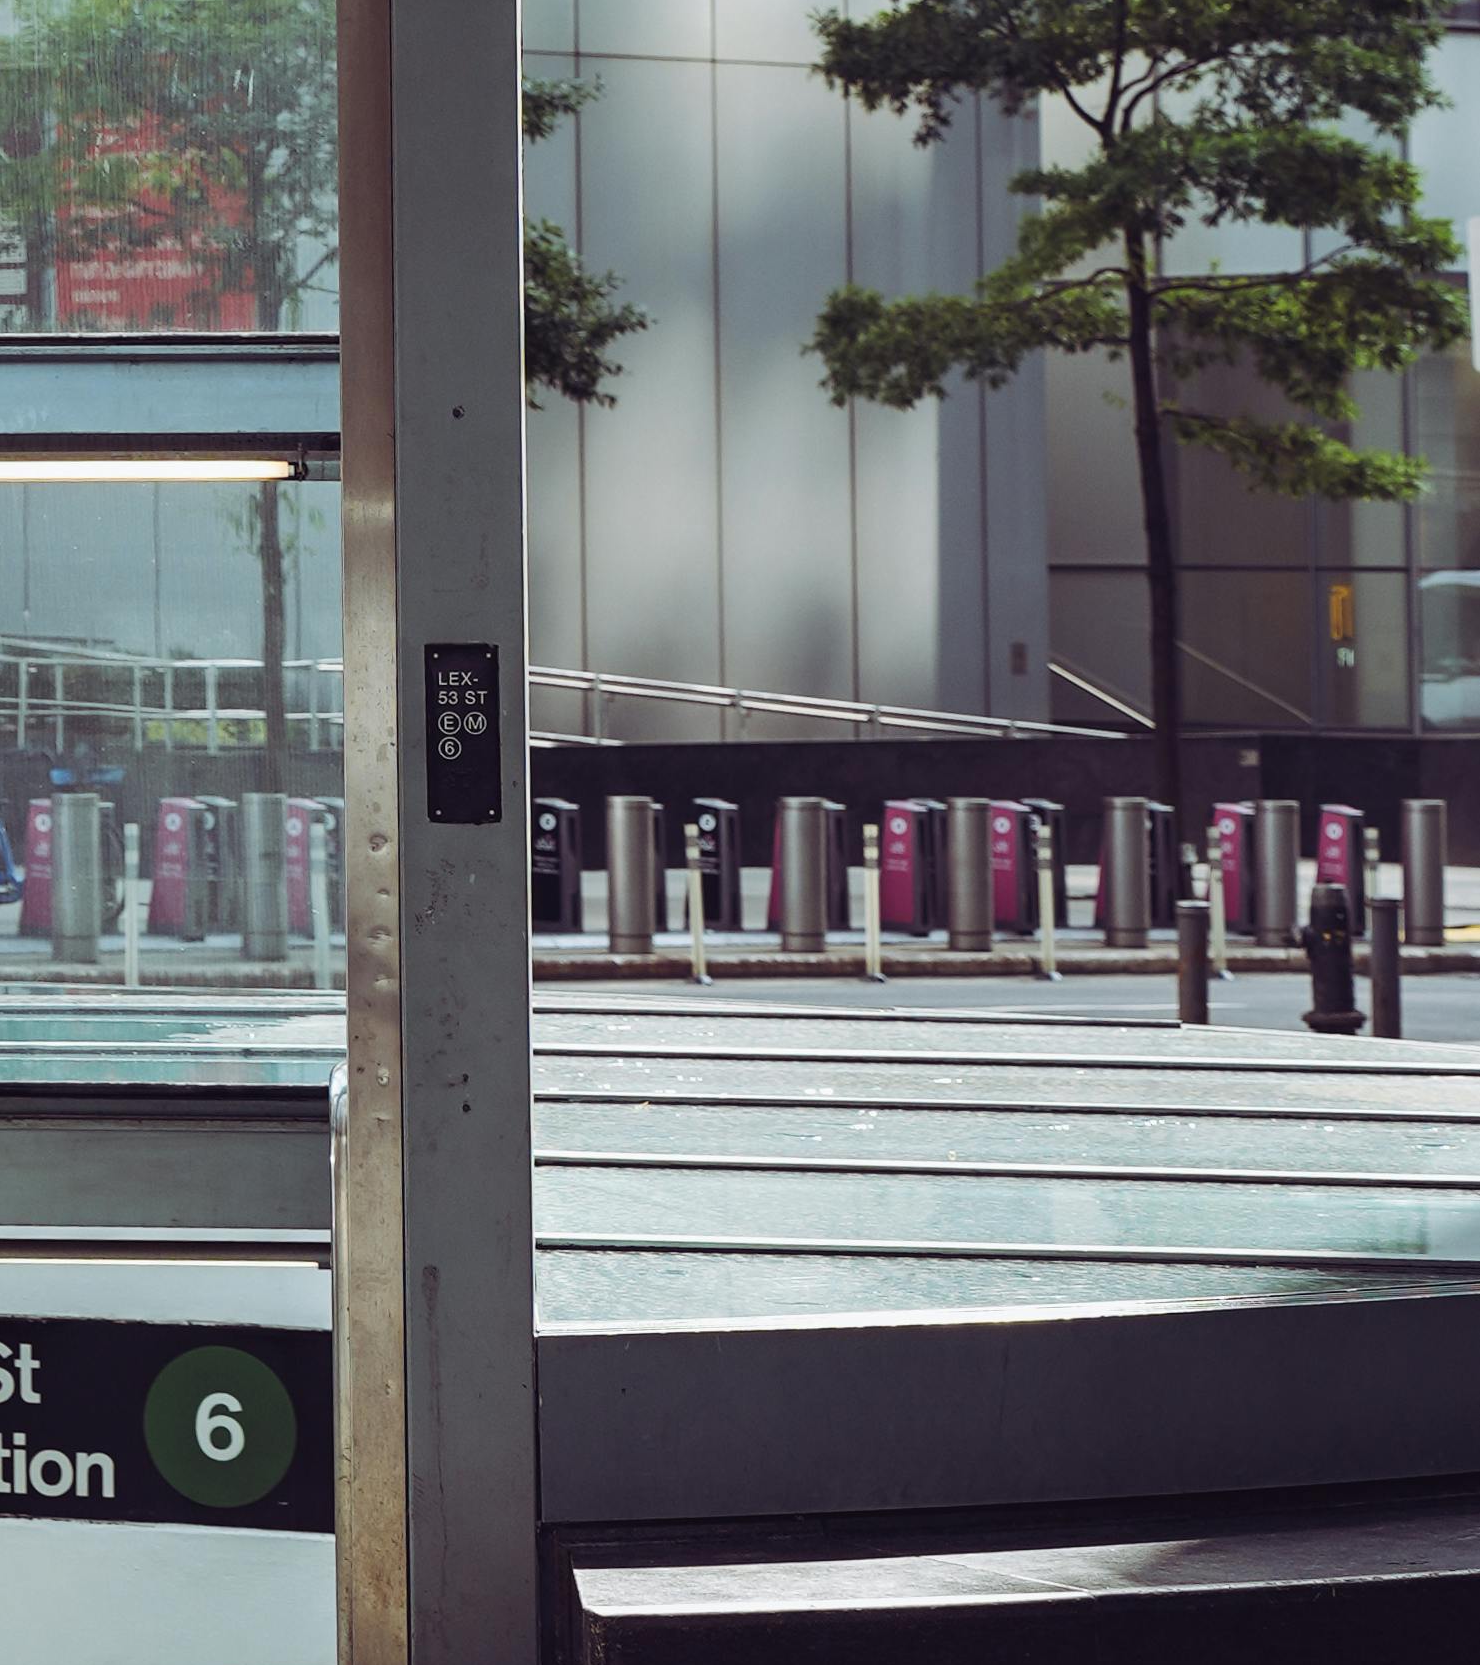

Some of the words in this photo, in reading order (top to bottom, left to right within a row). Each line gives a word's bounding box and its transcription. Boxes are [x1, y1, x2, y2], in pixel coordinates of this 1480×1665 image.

[438, 671, 479, 686] LEX-
[438, 690, 459, 705] 53
[465, 690, 488, 705] ST
[443, 715, 455, 730] E
[468, 716, 483, 729] M
[444, 741, 455, 756] 6
[194, 1392, 246, 1462] 6
